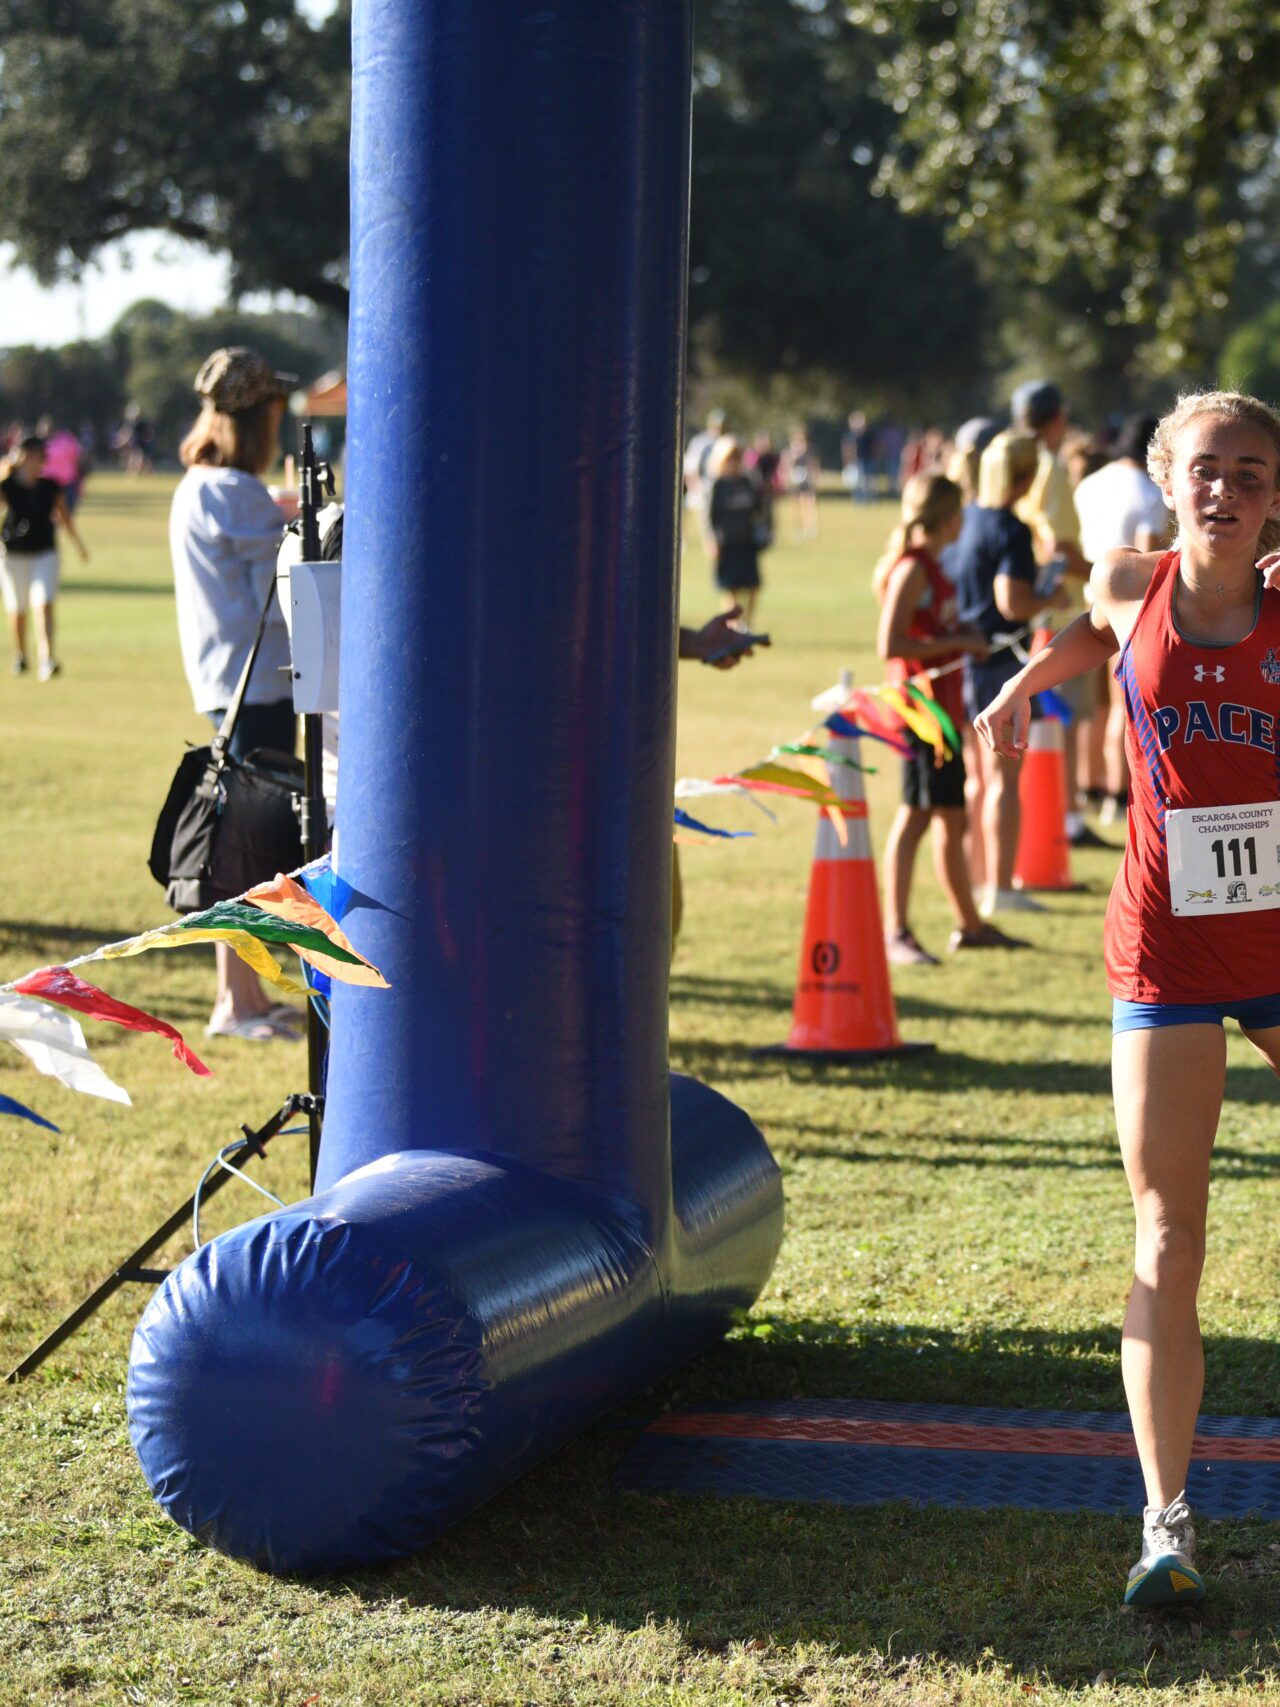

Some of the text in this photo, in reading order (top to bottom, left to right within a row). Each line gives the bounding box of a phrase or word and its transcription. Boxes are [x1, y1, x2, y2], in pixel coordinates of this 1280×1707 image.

[1151, 701, 1275, 754] PACE
[1191, 808, 1273, 823] ESCAROSA COUNTY
[1198, 820, 1269, 834] CHAMPIONSHIPS
[1211, 836, 1257, 878] 111
